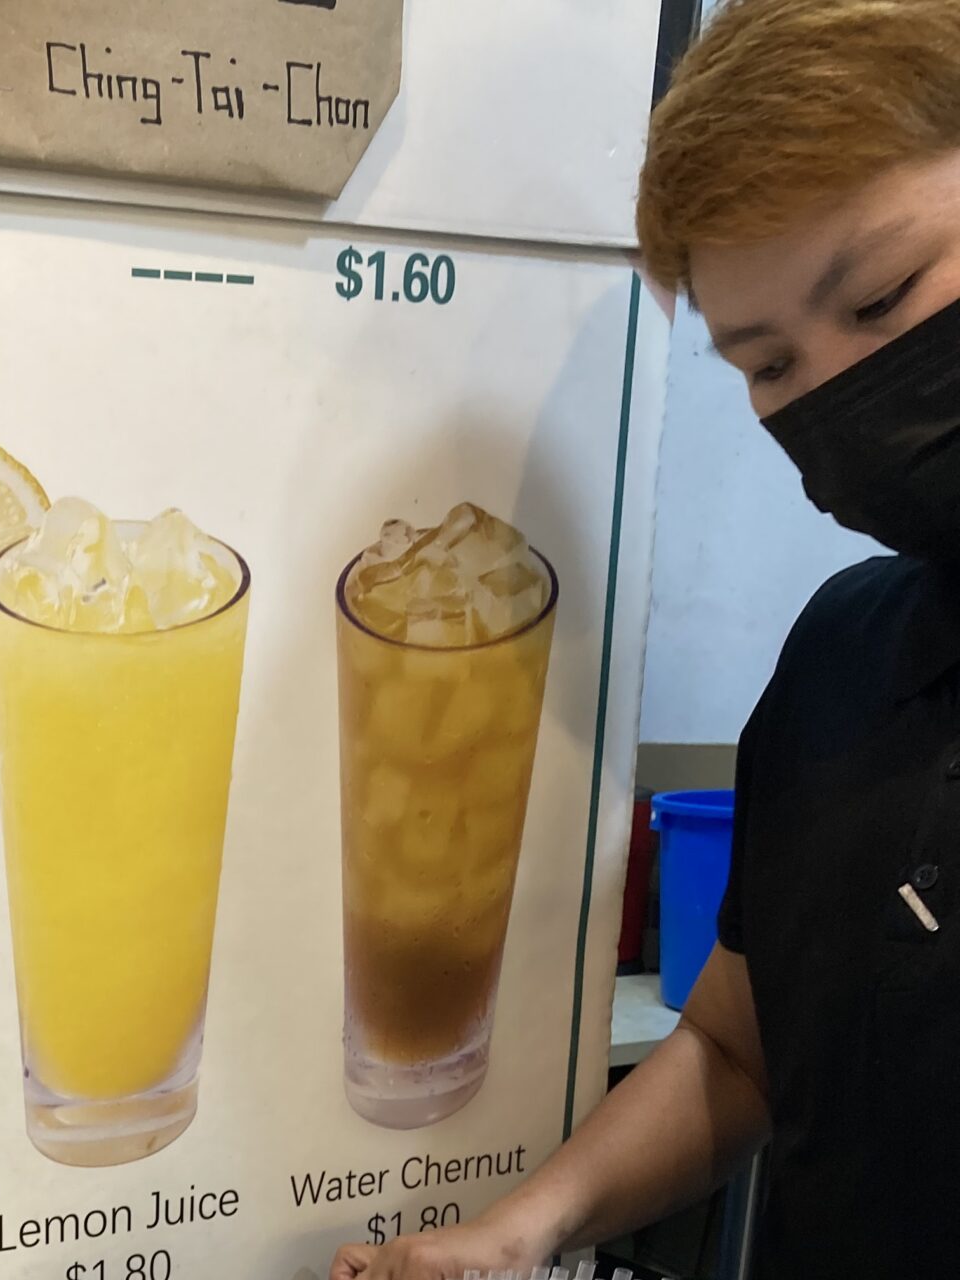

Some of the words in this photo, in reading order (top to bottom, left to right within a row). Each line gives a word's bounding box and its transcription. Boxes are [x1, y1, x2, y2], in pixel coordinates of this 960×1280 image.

[335, 245, 456, 305] $1.60
[290, 1168, 390, 1207] Water
[401, 1144, 527, 1190] Chernut
[146, 1184, 240, 1230] Juice
